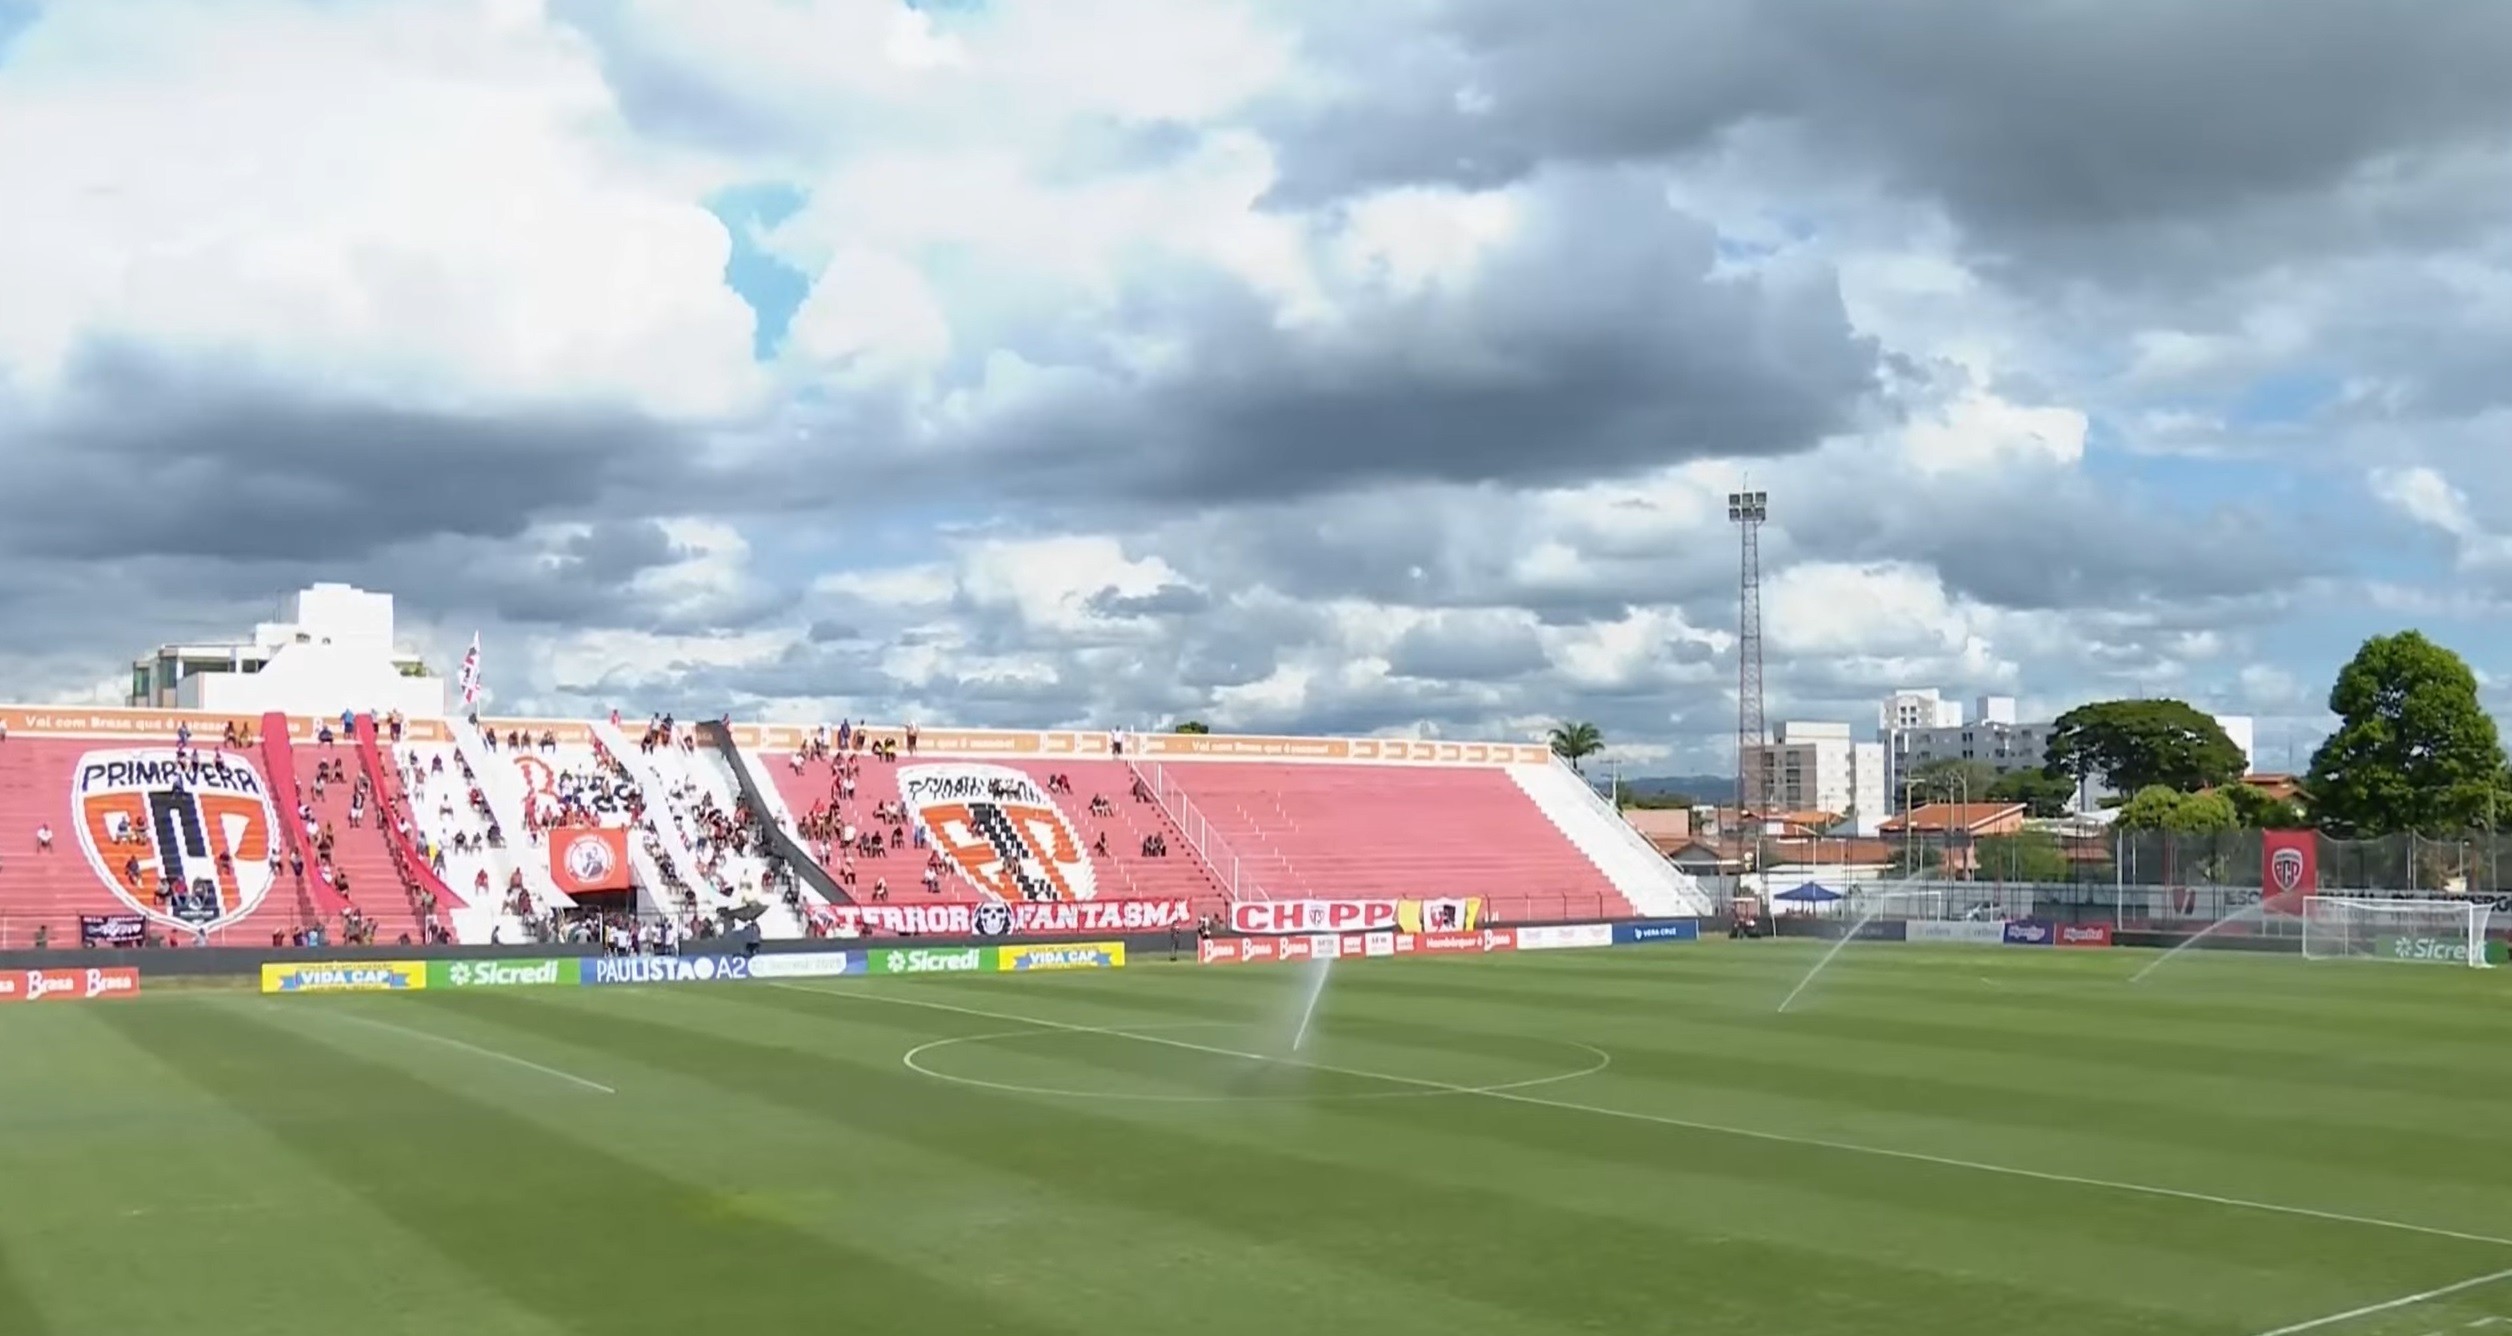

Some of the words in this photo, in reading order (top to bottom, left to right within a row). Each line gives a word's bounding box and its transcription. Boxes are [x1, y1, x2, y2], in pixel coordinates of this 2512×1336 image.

[25, 716, 51, 727] Vai
[55, 719, 86, 728] com
[91, 717, 131, 729] Brasa
[836, 905, 971, 937] TERROR
[1015, 899, 1190, 930] FANTASMA
[908, 949, 980, 972] Sicredi
[1029, 952, 1064, 963] VIDA
[1067, 950, 1098, 961] CAP
[301, 971, 347, 984] VIDA
[351, 970, 389, 983] CAP
[474, 961, 558, 984] Sicredi
[716, 957, 747, 979] A2
[26, 970, 74, 999] Brasa
[85, 968, 131, 997] Brasa
